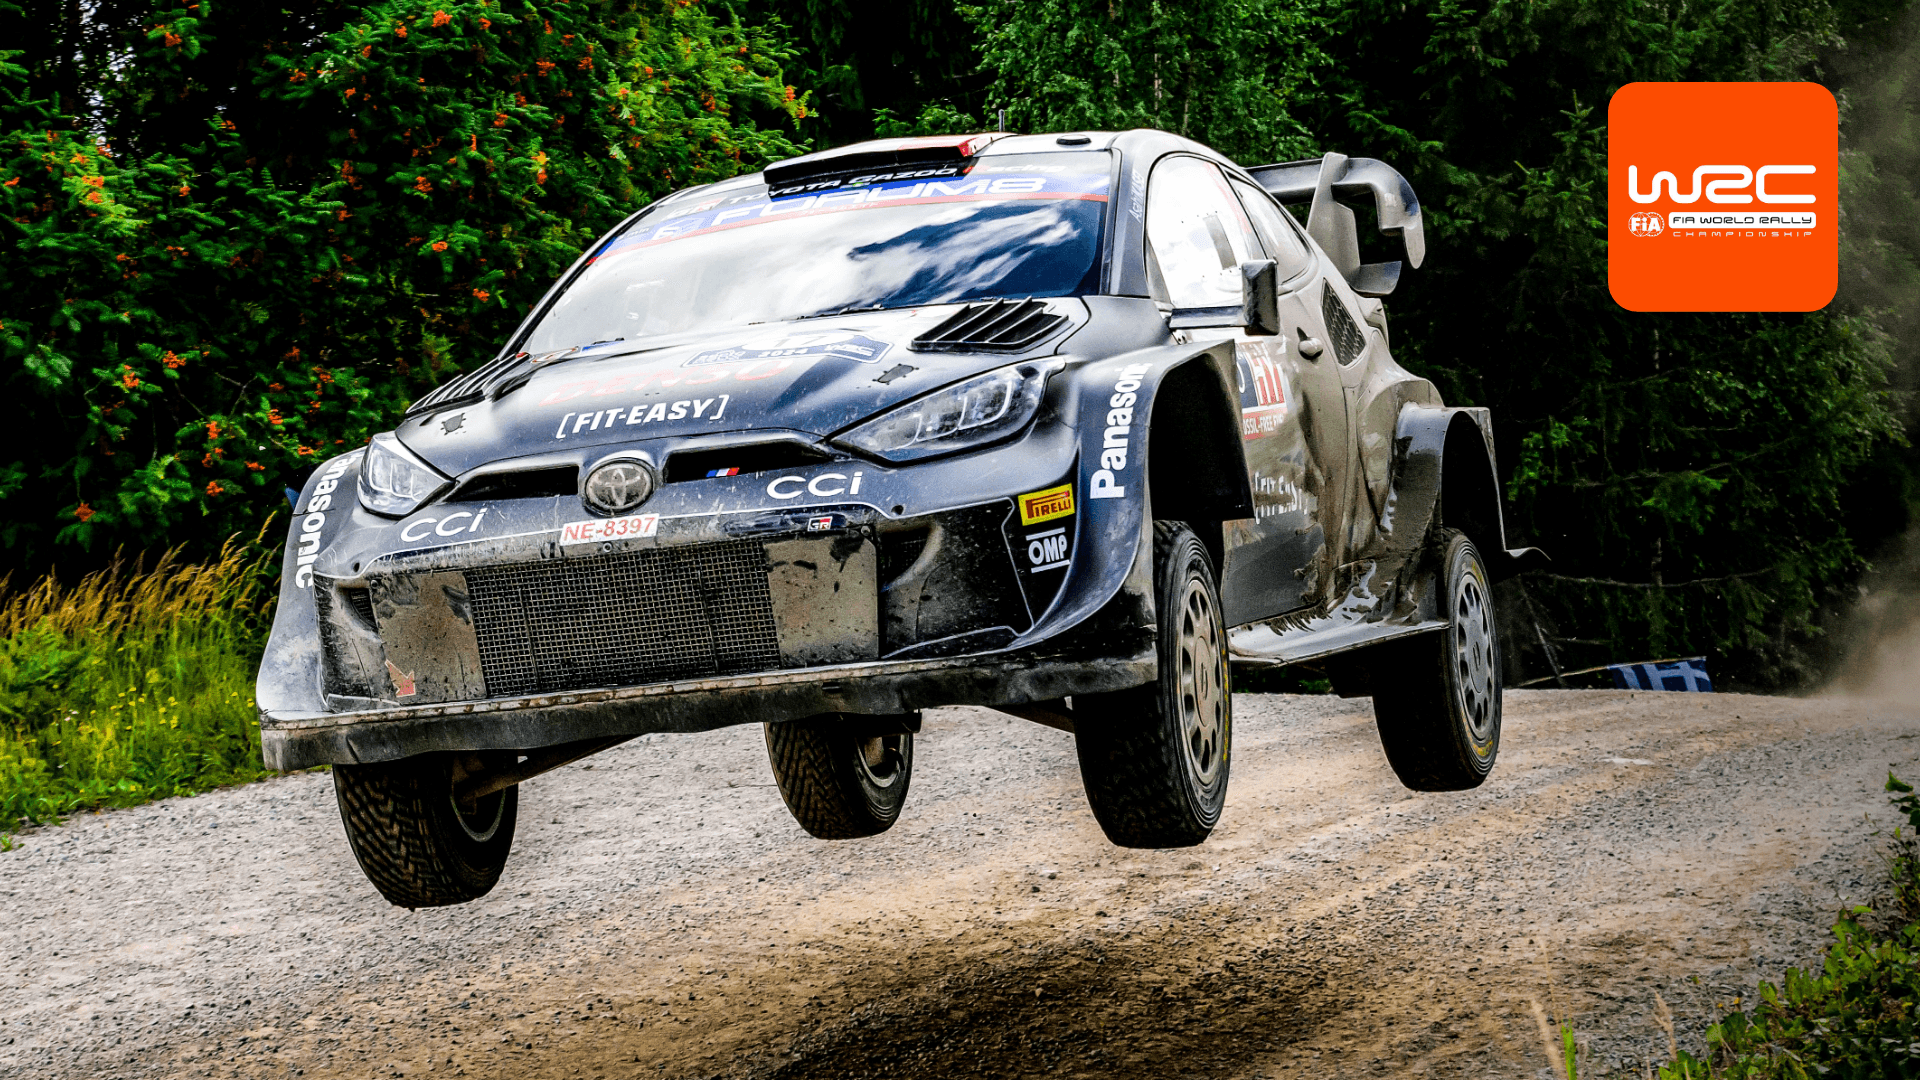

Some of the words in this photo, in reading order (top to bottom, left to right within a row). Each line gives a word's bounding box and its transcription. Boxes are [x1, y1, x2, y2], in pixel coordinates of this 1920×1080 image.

[848, 167, 958, 185] GAZOO
[711, 177, 1047, 227] FORUM8
[539, 359, 793, 407] DENSO
[1025, 490, 1071, 519] PIRELLI
[563, 515, 656, 542] NE-8397
[1027, 532, 1069, 566] OMP
